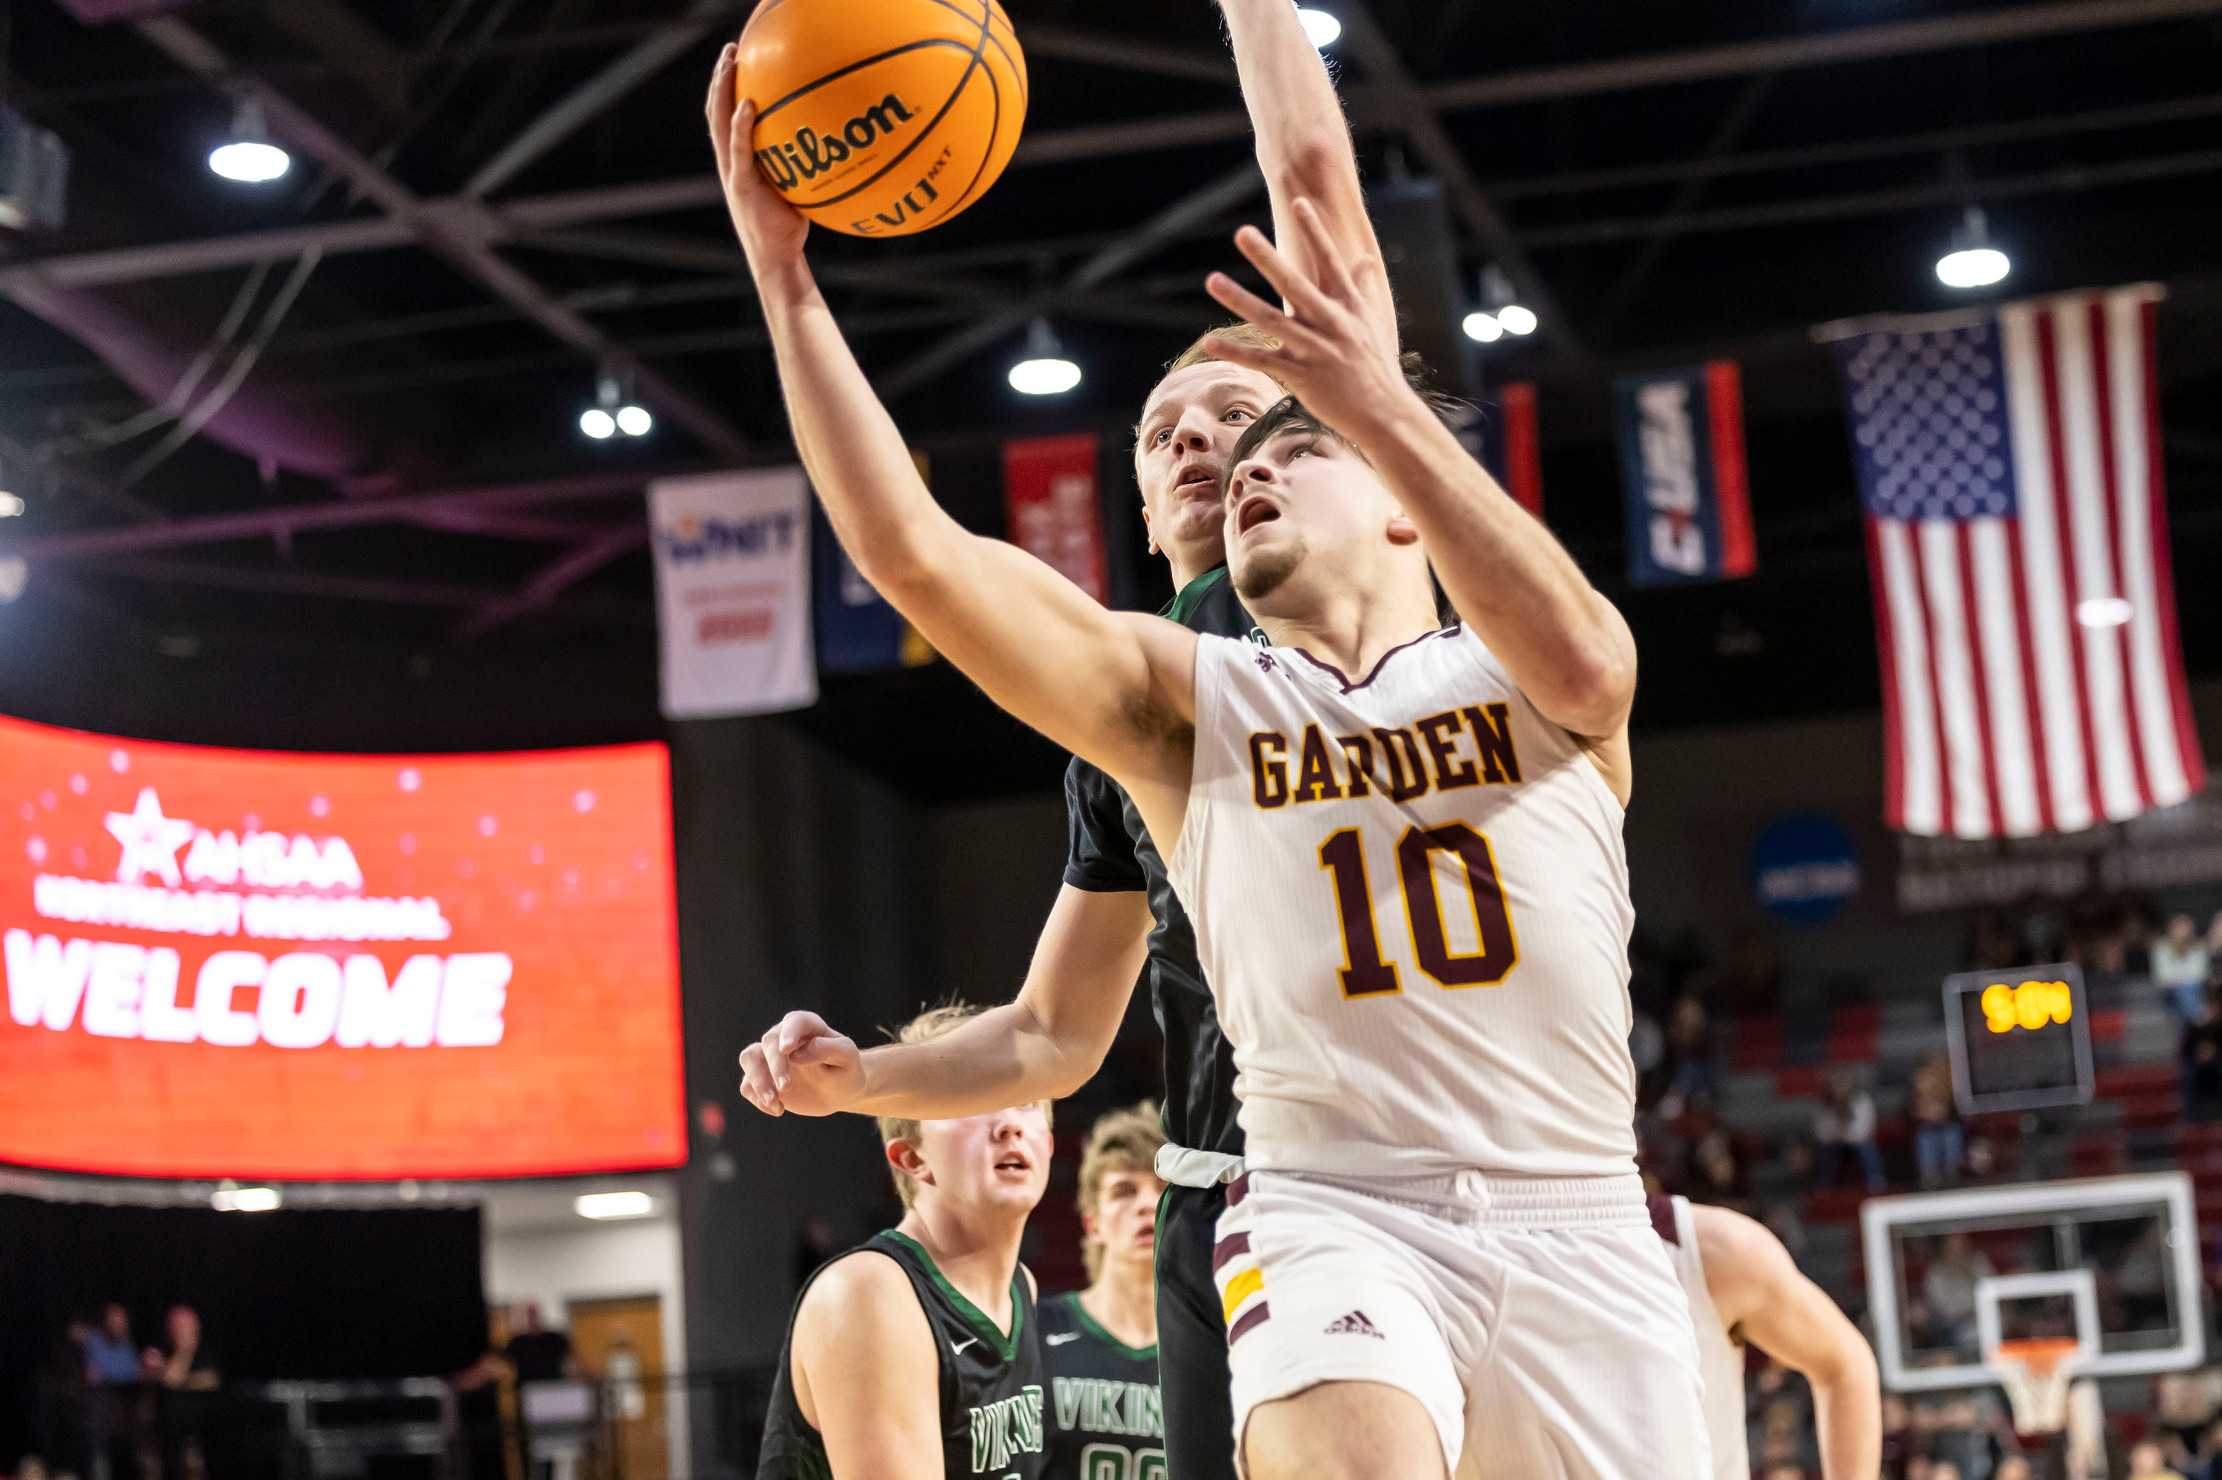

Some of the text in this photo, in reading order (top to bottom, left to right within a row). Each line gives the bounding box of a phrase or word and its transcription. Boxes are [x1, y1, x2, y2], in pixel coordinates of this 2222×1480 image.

[754, 94, 914, 191] Wilson
[1249, 702, 1522, 810] GARDEN
[1318, 820, 1520, 1000] 10
[3, 928, 512, 1048] WELCOME
